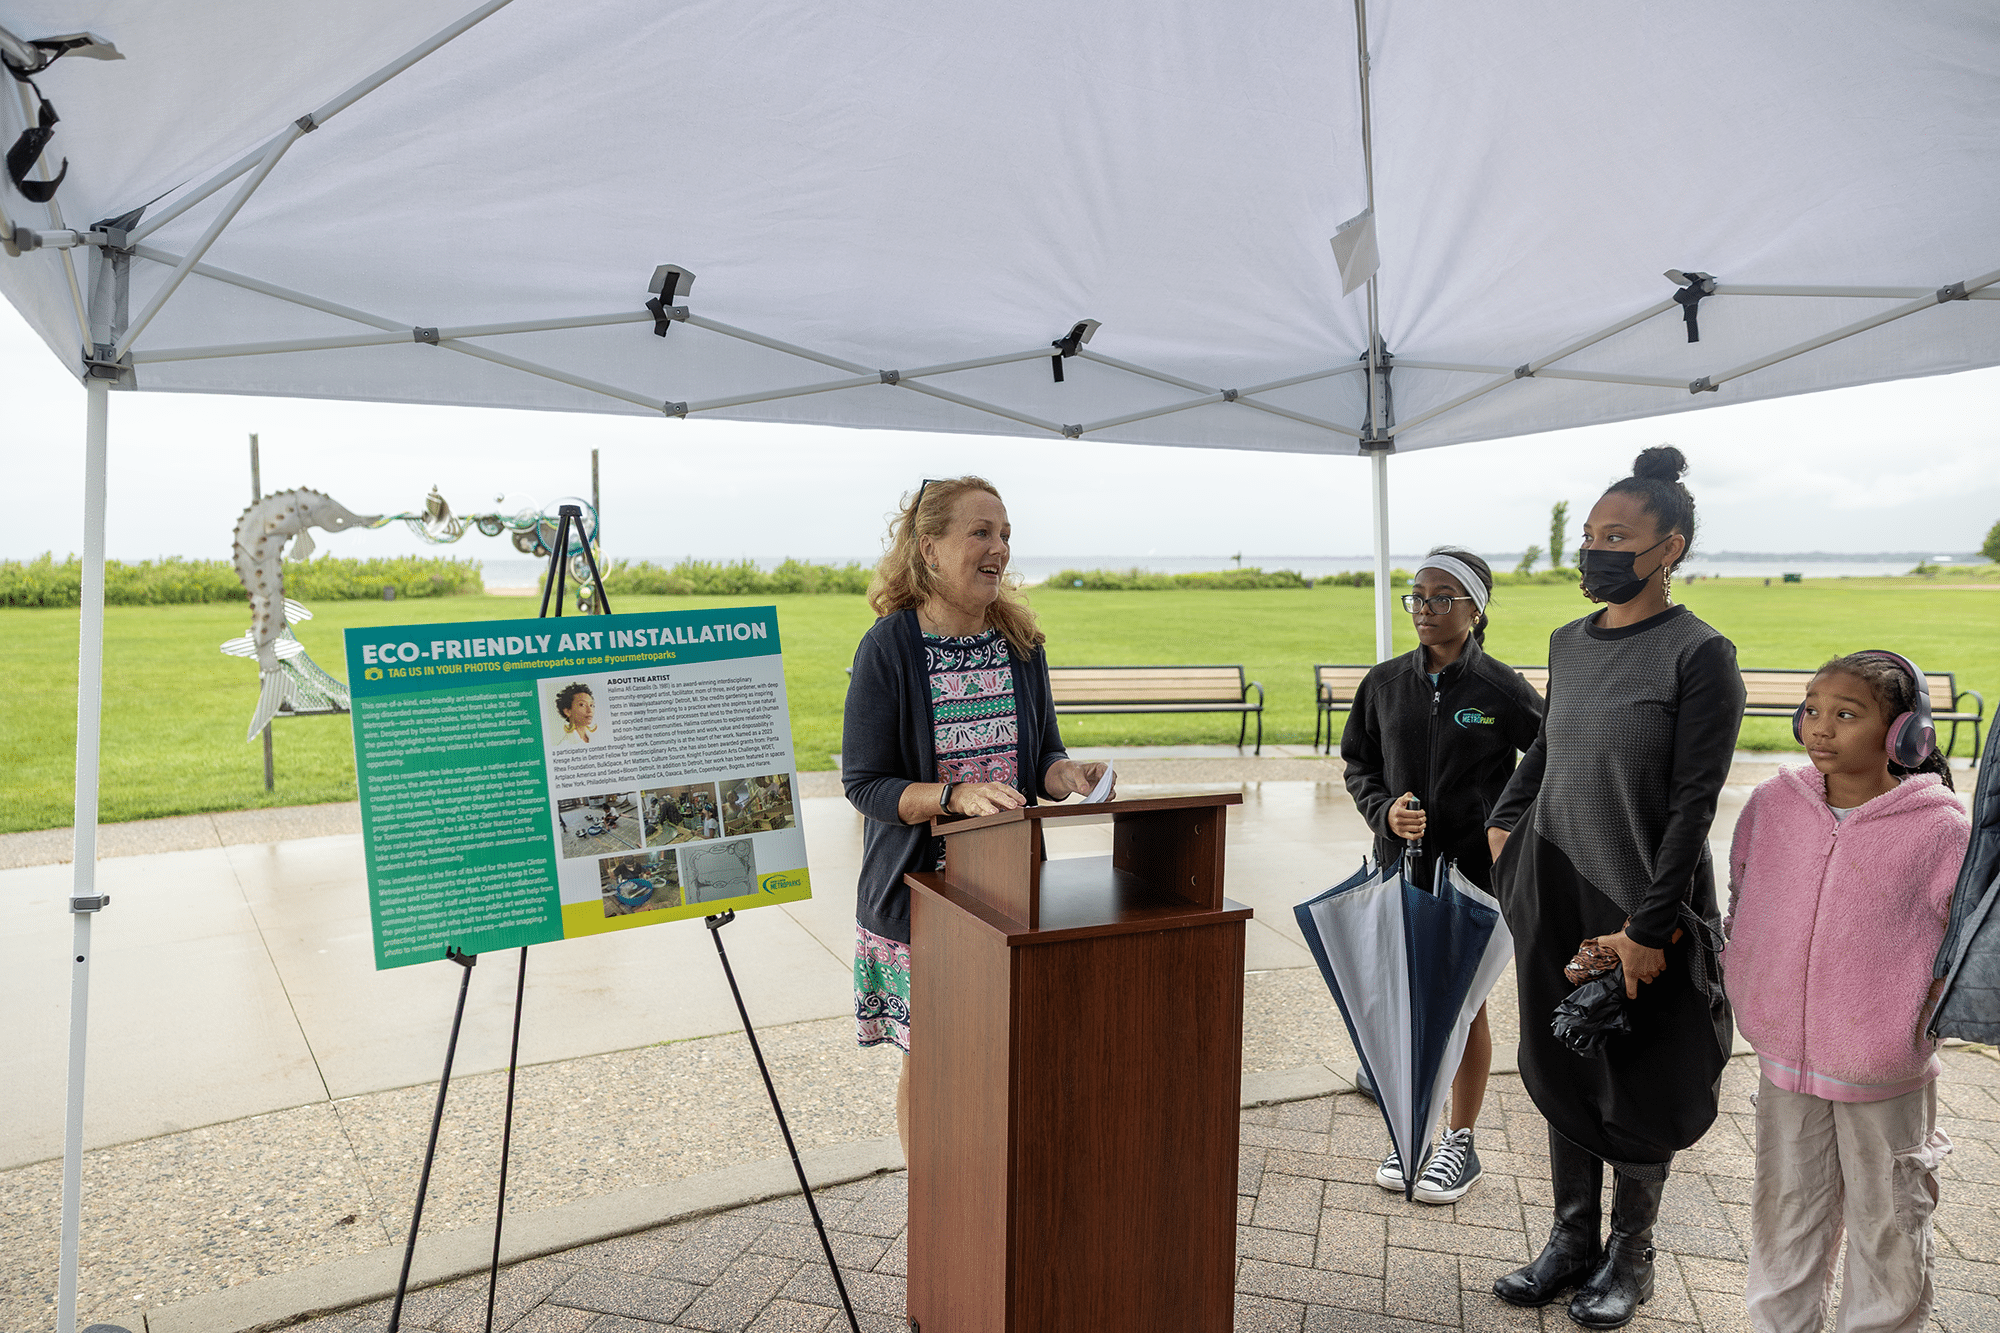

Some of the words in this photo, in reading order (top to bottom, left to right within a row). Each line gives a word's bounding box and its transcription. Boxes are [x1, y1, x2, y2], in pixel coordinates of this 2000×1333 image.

[362, 634, 551, 664] ECO-FRIENDLY
[558, 631, 604, 652] ART
[608, 622, 768, 649] INSTALLATION
[388, 668, 407, 678] TAG
[409, 667, 422, 676] US
[424, 666, 434, 676] IN
[436, 664, 462, 675] YOUR
[464, 662, 501, 673] PHOTOS
[502, 656, 574, 672] @mimetroparks
[587, 656, 603, 664] use
[604, 650, 676, 665] #yourmetroparks
[607, 676, 632, 686] ABOUT
[633, 675, 646, 684] THE
[647, 674, 670, 682] ARTIST
[659, 682, 671, 690] 1981)
[682, 679, 716, 688] award-winning
[717, 676, 752, 686] interdisciplinary
[608, 691, 658, 702] community-engaged
[725, 692, 748, 701] gardening
[754, 690, 774, 698] inspiring
[658, 706, 678, 714] painting
[688, 703, 706, 712] practice
[730, 700, 747, 708] aspires
[622, 717, 643, 726] upcycled
[733, 707, 750, 716] thriving
[762, 704, 779, 713] (human
[728, 715, 745, 724] explore
[745, 713, 772, 722] relationship-
[742, 721, 769, 730] disposability
[553, 756, 570, 766] Kresge
[629, 747, 667, 758] Interdisciplinary
[740, 738, 754, 746] grants
[556, 746, 588, 757] participatory
[607, 743, 626, 752] through
[650, 738, 677, 748] Community
[686, 751, 702, 760] Knight
[702, 748, 727, 757] Foundation
[555, 773, 576, 782] Artplace
[576, 770, 596, 779] America
[607, 766, 638, 775] Seed+Bloom
[662, 761, 681, 769] addition
[636, 772, 656, 780] Oakland
